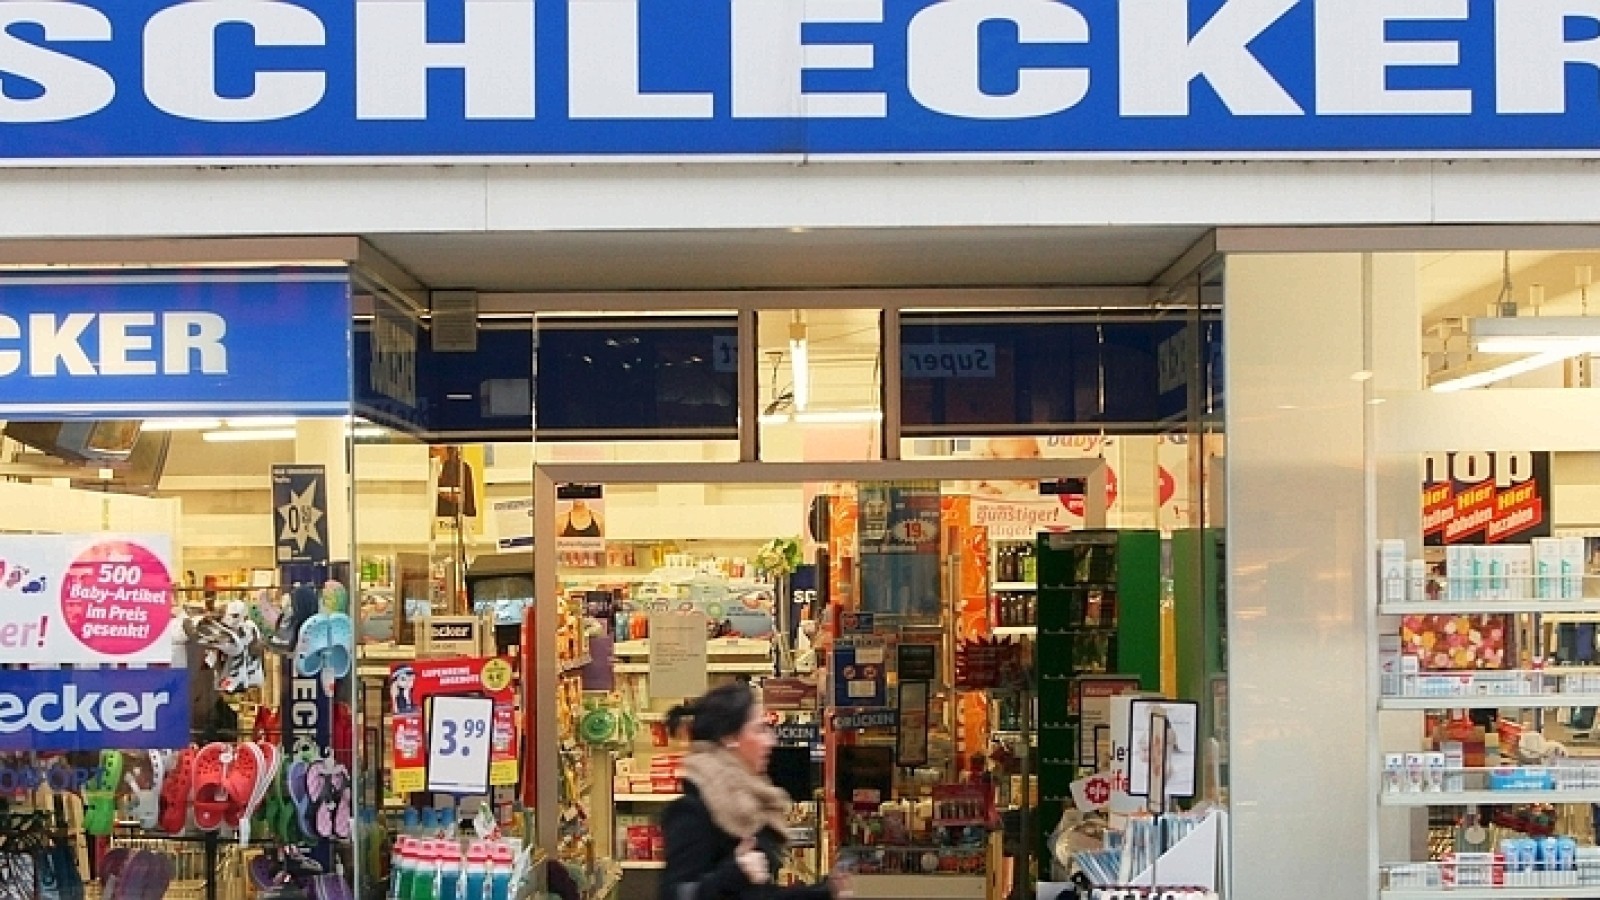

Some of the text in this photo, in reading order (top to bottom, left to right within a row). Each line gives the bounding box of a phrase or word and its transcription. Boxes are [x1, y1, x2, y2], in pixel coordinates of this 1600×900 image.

[0, 0, 1600, 121] SCHLECKER
[97, 564, 141, 584] 500
[70, 583, 166, 604] Baby-Artikel
[86, 604, 107, 619] im
[108, 606, 148, 622] Preis
[82, 623, 150, 639] gesenkt!
[0, 685, 170, 732] ecker
